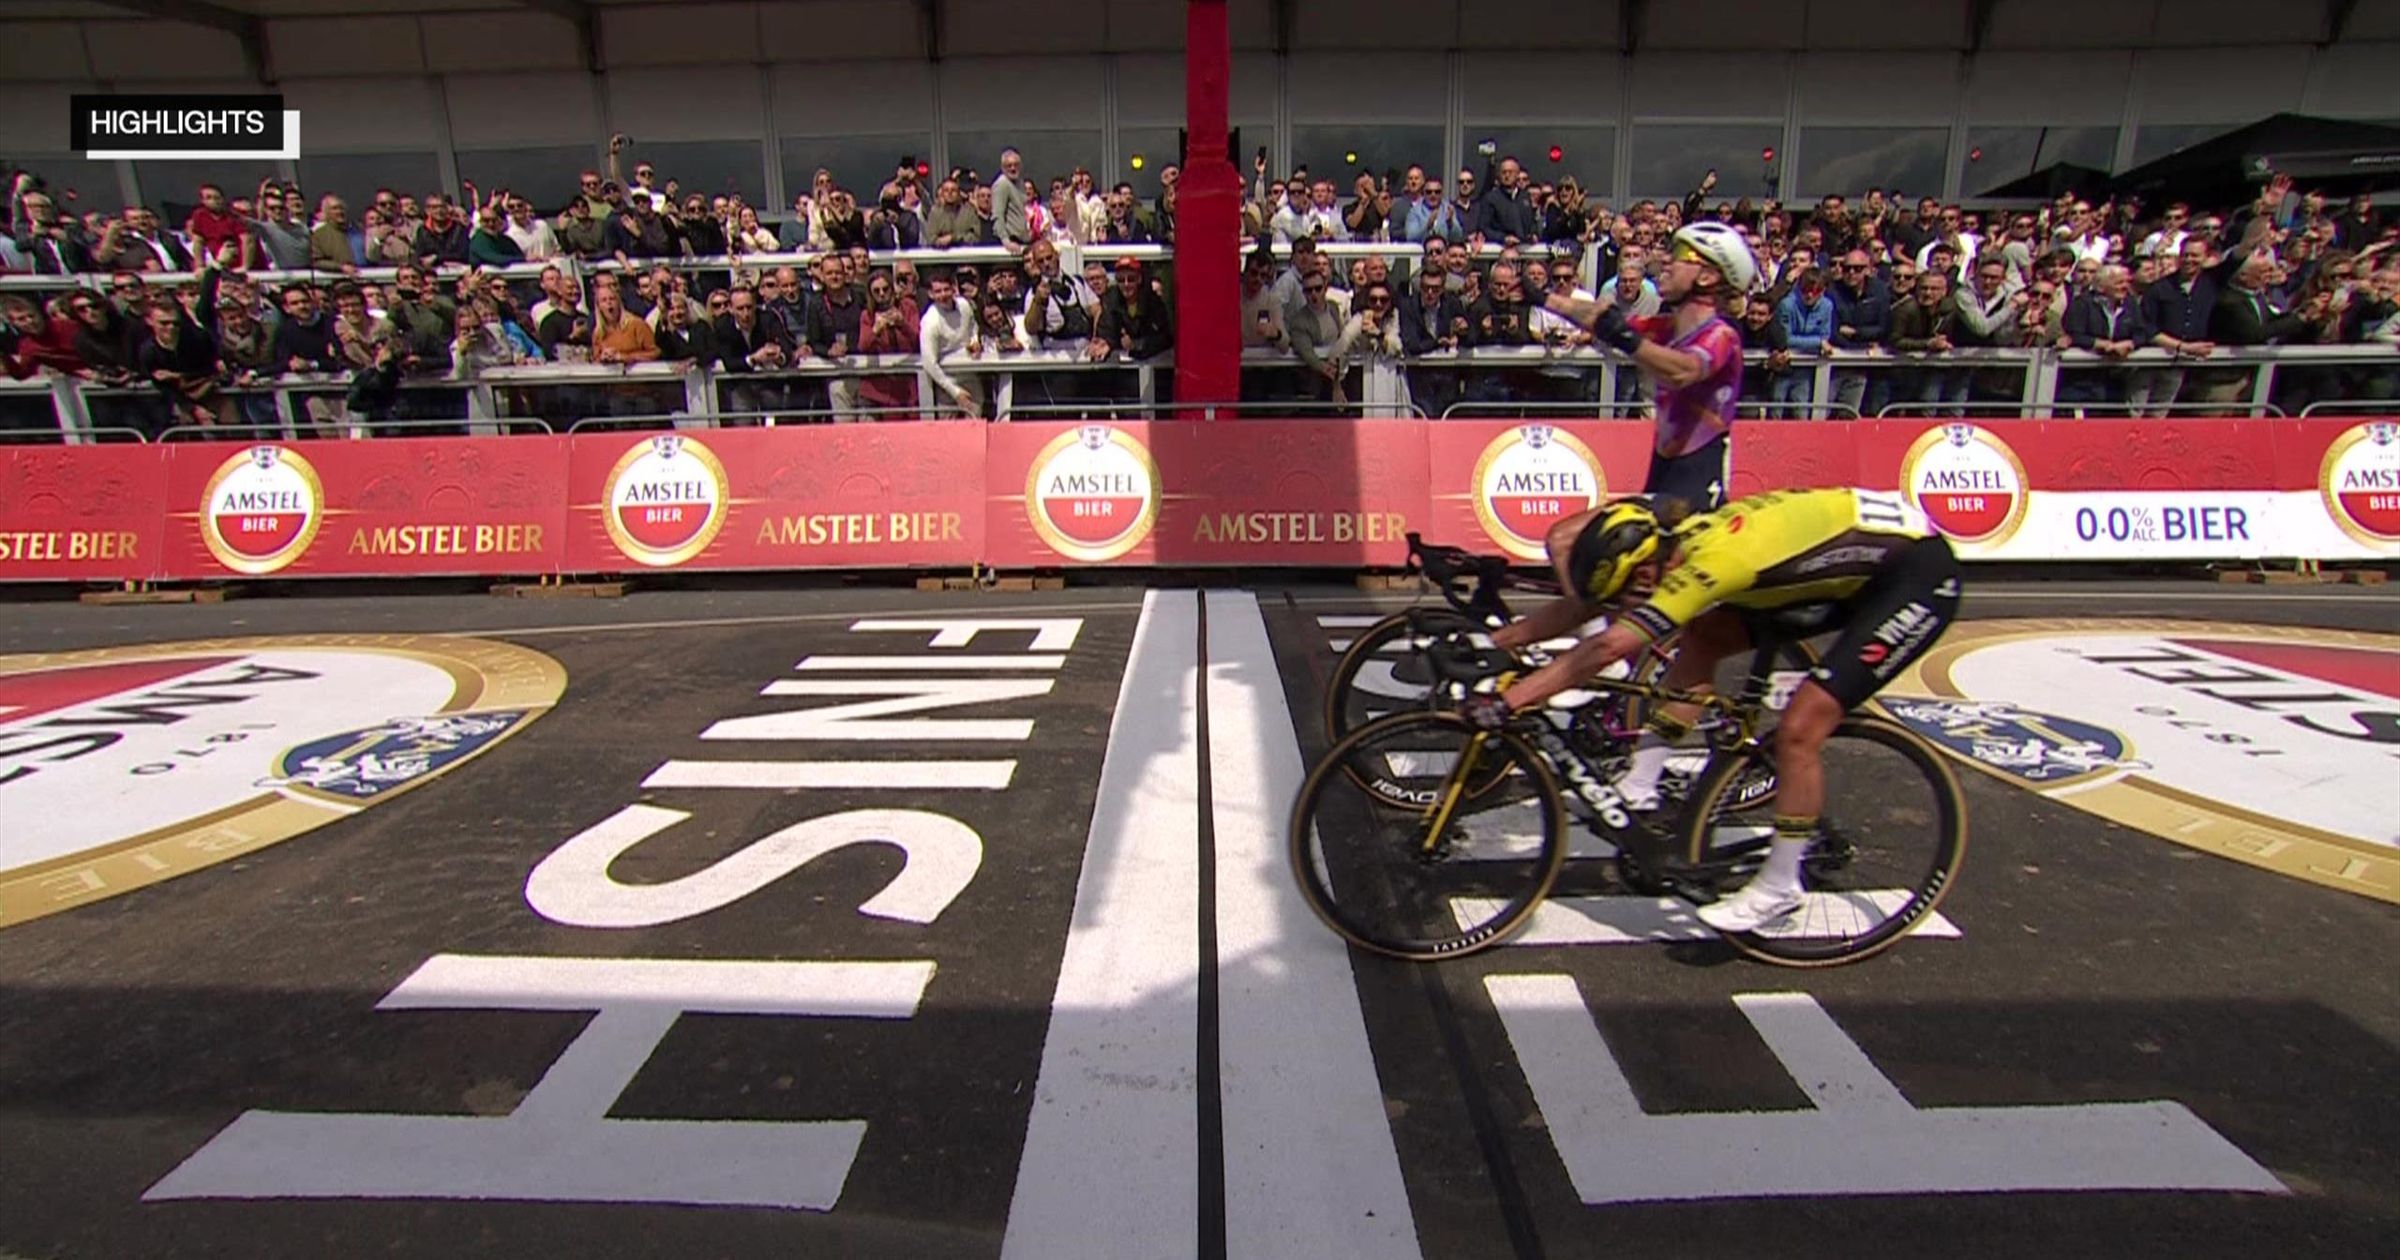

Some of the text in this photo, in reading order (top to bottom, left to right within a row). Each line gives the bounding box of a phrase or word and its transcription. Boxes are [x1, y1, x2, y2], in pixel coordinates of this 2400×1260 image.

[1050, 474, 1137, 494] AMSTEL
[1497, 473, 1583, 492] AMSTEL
[1924, 470, 2006, 489] AMSTEL
[2344, 470, 2400, 488] AMS
[222, 491, 301, 511] AMSTEL
[625, 481, 706, 502] AMSTEL
[1074, 501, 1113, 517] BIER
[1521, 500, 1560, 515] BIER
[1947, 497, 1985, 512] BIER
[2370, 495, 2400, 510] BIE
[242, 517, 279, 532] BIER
[646, 507, 683, 523] BIER
[2163, 507, 2250, 540] BIER
[756, 512, 963, 545] AMSTEL BIER
[1194, 513, 1407, 543] AMSTEL BIER
[69, 531, 138, 559] BIER
[348, 524, 543, 554] AMSTEL BIER
[0, 665, 322, 784] AMS
[140, 618, 1084, 1212] FINISH
